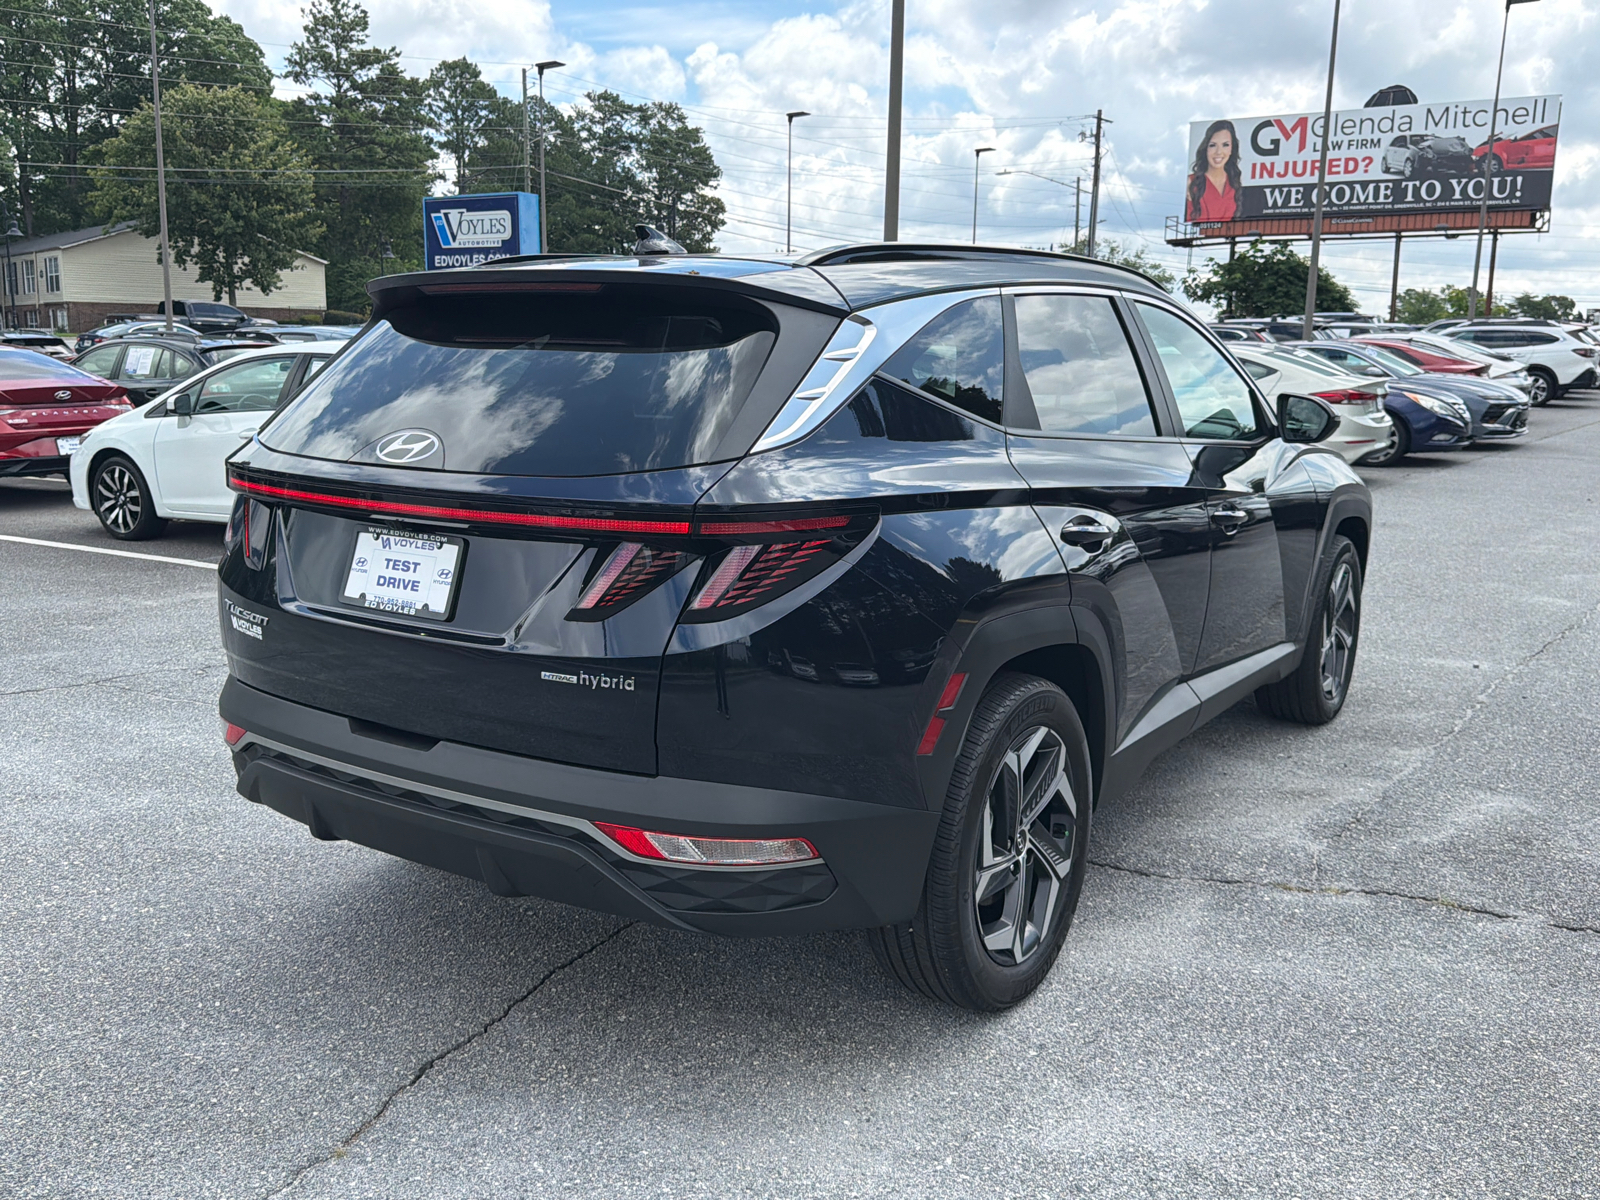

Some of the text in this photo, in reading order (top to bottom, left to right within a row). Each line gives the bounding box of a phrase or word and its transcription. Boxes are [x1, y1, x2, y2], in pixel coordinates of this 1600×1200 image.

[1311, 98, 1547, 138] Glenda Mitchell
[1250, 116, 1309, 157] GM
[1347, 138, 1382, 150] FIRM
[1250, 156, 1374, 179] INJURED?
[1263, 175, 1523, 207] WE COME TO YOU!
[442, 211, 507, 243] VOYLES
[368, 526, 448, 543] WWW.EDVOYLES.COM
[393, 537, 435, 551] VOYLES
[384, 558, 421, 573] TEST
[376, 575, 421, 592] DRIVE
[224, 598, 269, 626] TUCSON
[364, 600, 416, 615] ED VOYLES
[237, 618, 263, 635] VOYLES
[543, 670, 636, 691] HTRAC hybrid
